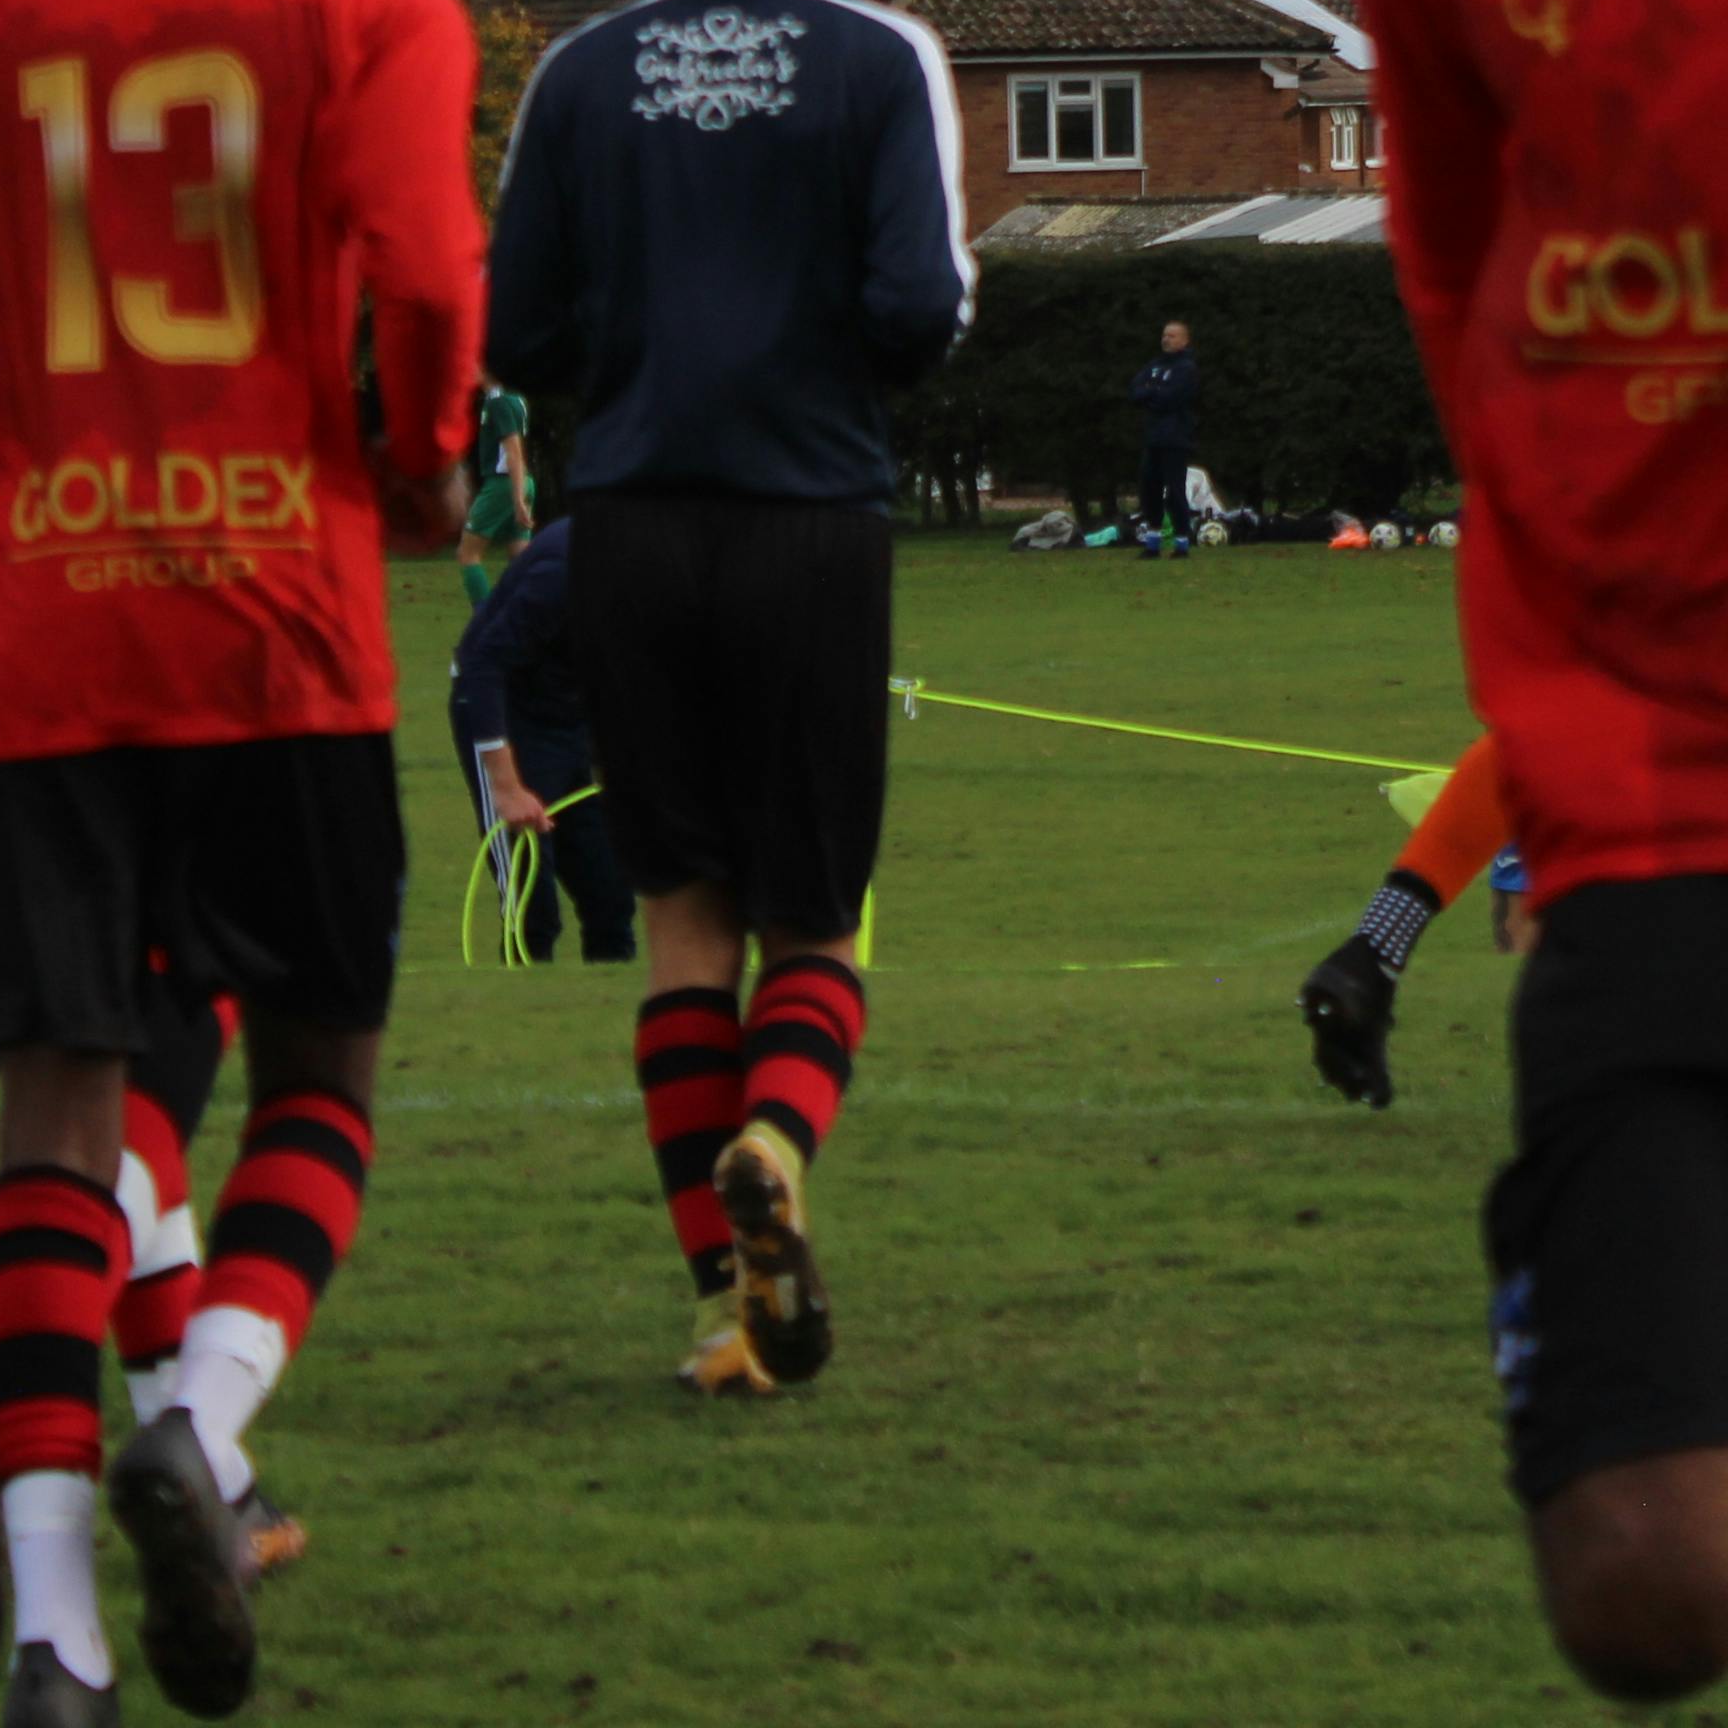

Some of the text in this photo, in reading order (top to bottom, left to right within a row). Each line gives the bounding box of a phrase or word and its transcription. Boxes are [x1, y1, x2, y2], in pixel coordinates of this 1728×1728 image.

[17, 49, 262, 373] 13
[11, 450, 318, 542] GOLDEX
[65, 555, 258, 593] GROUP
